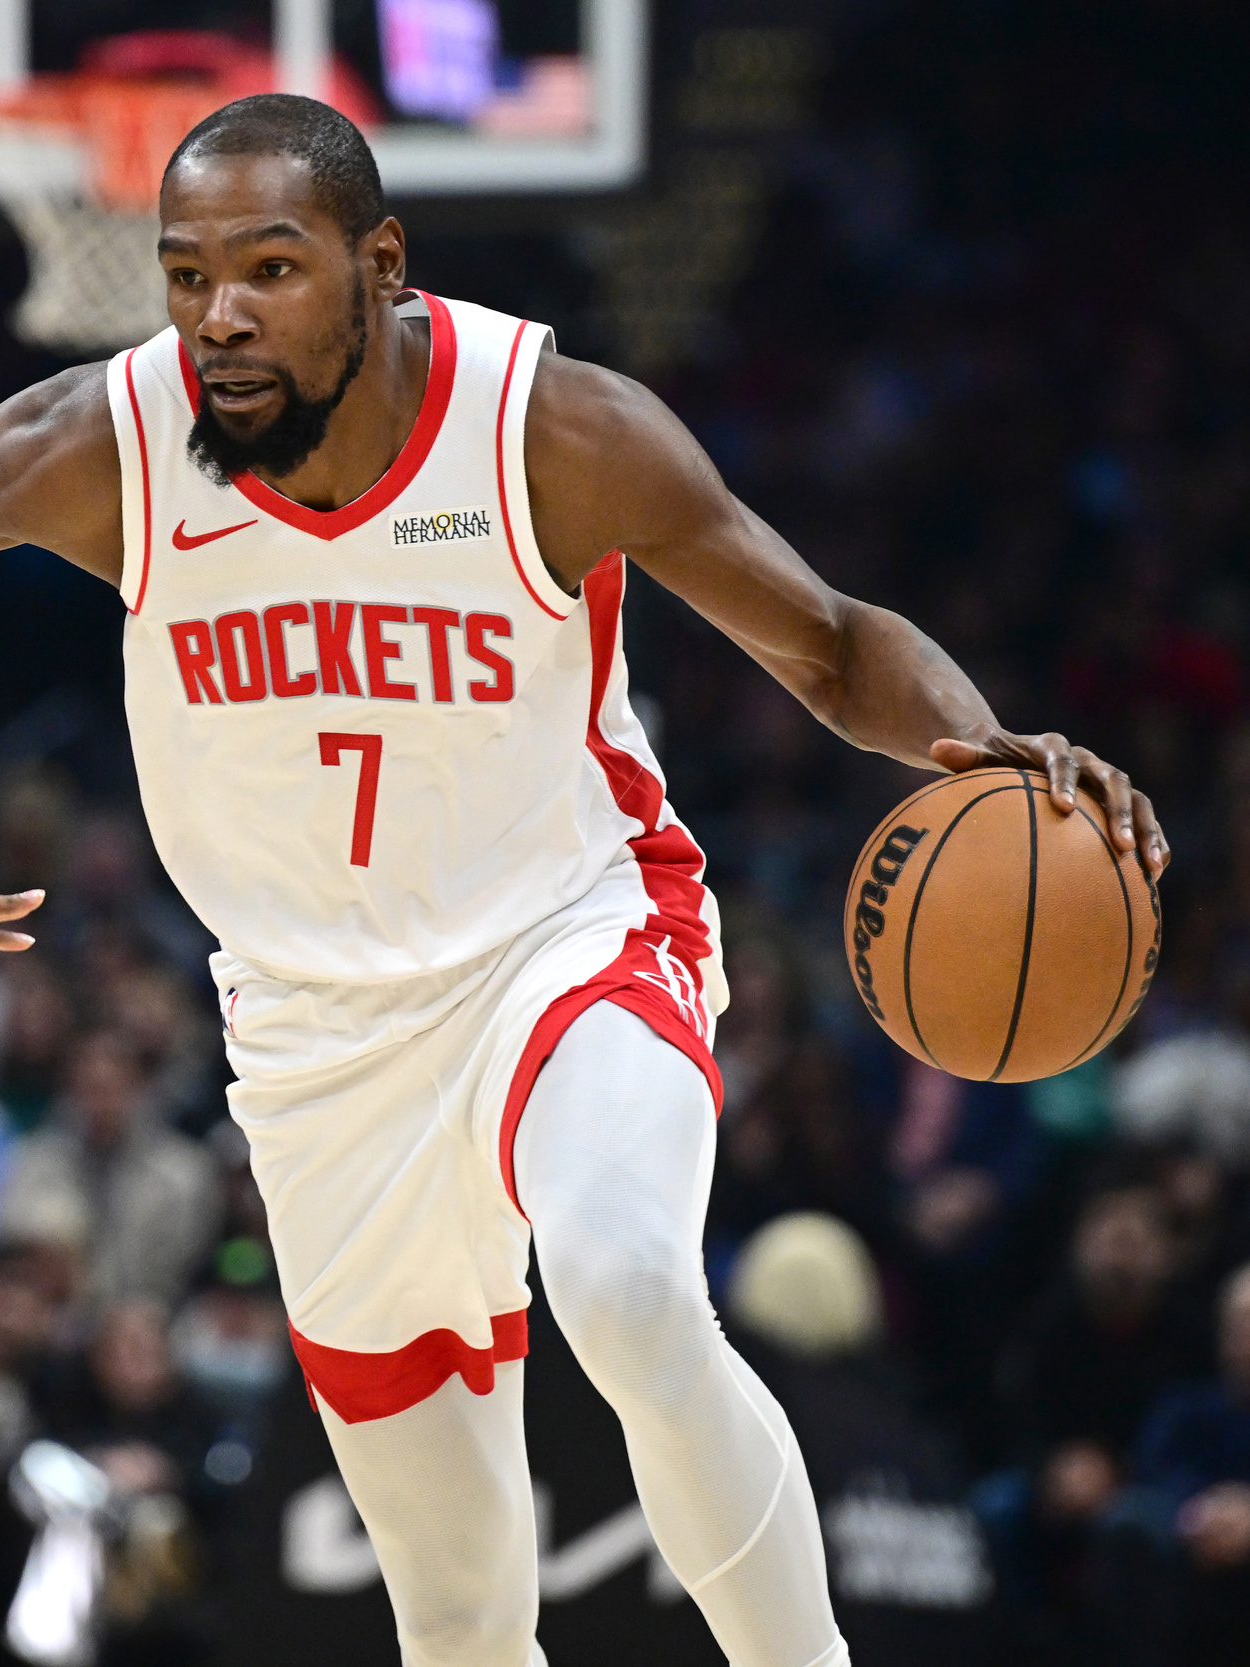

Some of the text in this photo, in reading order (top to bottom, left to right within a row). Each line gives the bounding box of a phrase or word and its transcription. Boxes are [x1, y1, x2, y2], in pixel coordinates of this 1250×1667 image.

[393, 511, 490, 532] MEMORIAL
[393, 522, 490, 545] HERMANN
[166, 599, 516, 706] ROCKETS
[317, 732, 383, 868] 7
[853, 824, 930, 1021] Wilson
